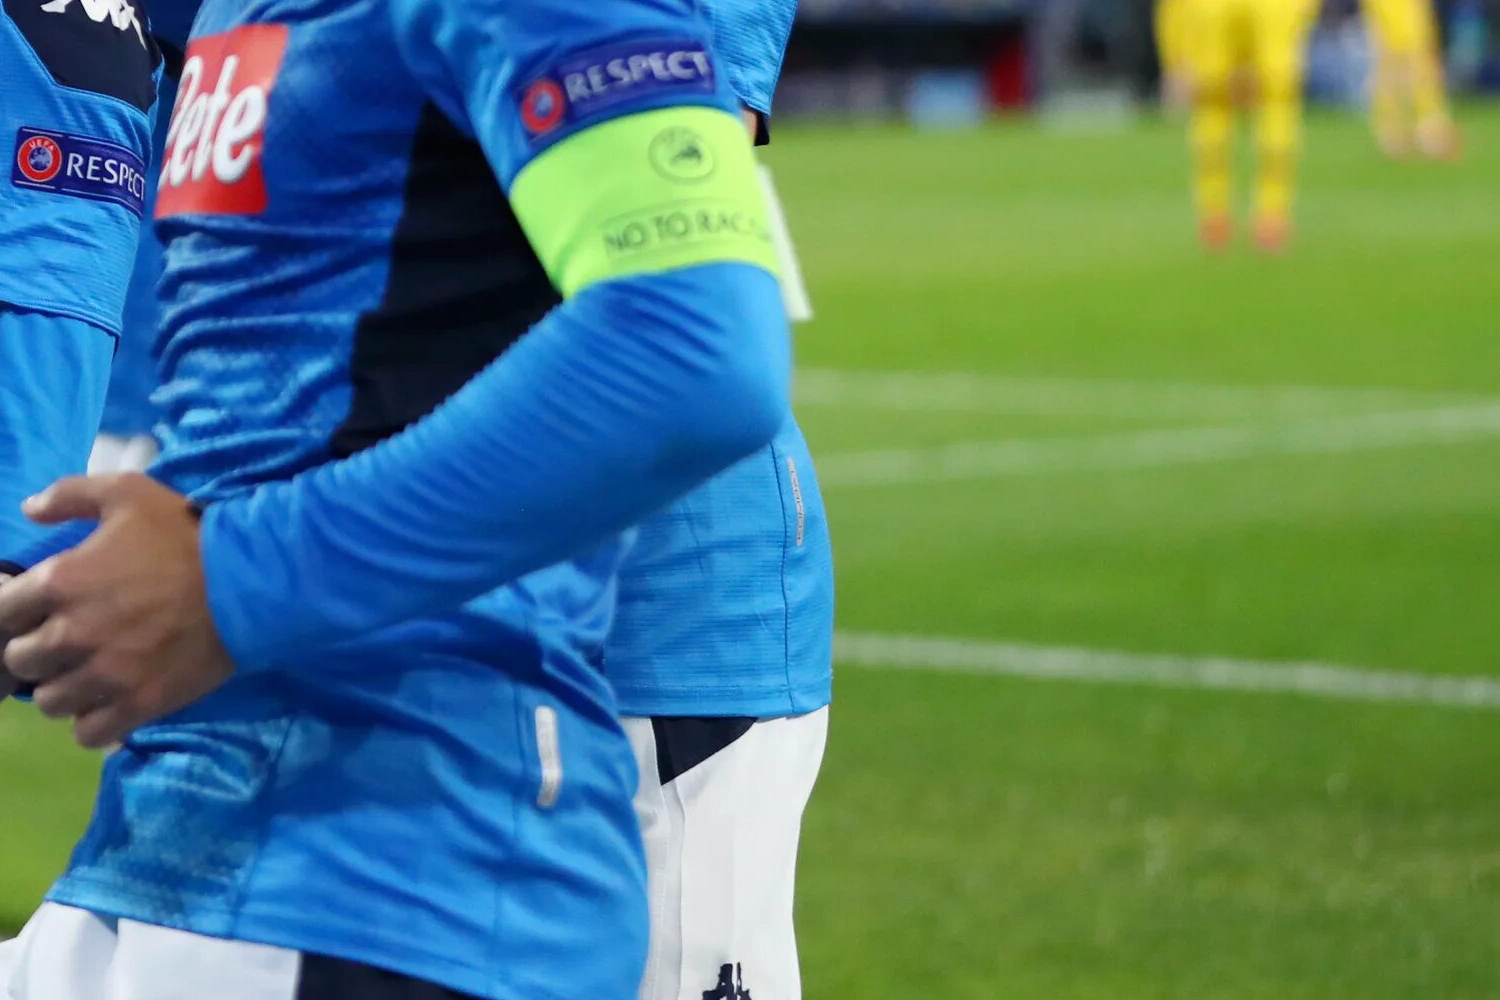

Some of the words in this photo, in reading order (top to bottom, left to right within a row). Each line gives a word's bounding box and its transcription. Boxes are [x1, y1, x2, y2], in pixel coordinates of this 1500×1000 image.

[563, 50, 710, 104] RESPECT
[27, 138, 56, 152] UEFA
[65, 152, 146, 201] RESPECT
[603, 220, 649, 250] NO
[653, 211, 692, 241] TO
[695, 208, 772, 243] RAC
